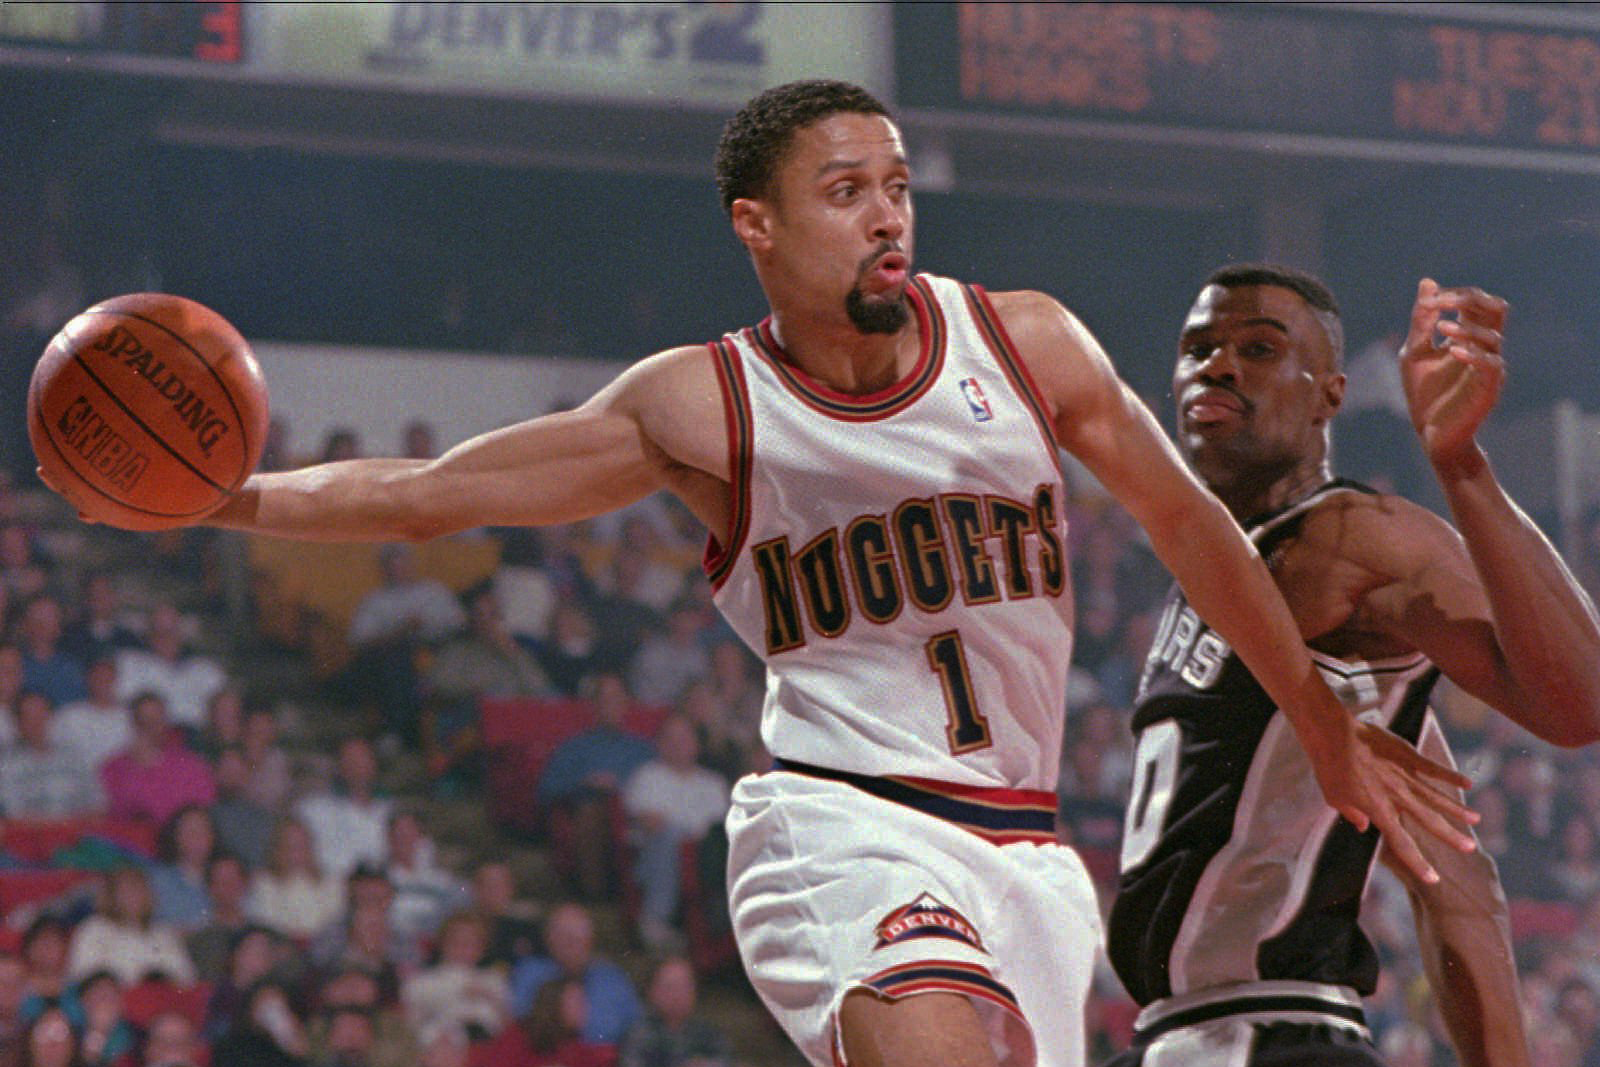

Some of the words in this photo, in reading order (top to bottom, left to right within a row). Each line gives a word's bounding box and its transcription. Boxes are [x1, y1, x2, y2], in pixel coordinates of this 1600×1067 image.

[92, 325, 228, 452] SPALDING
[751, 483, 1066, 656] NUGGETS
[924, 629, 993, 757] 1
[1120, 716, 1182, 874] 0
